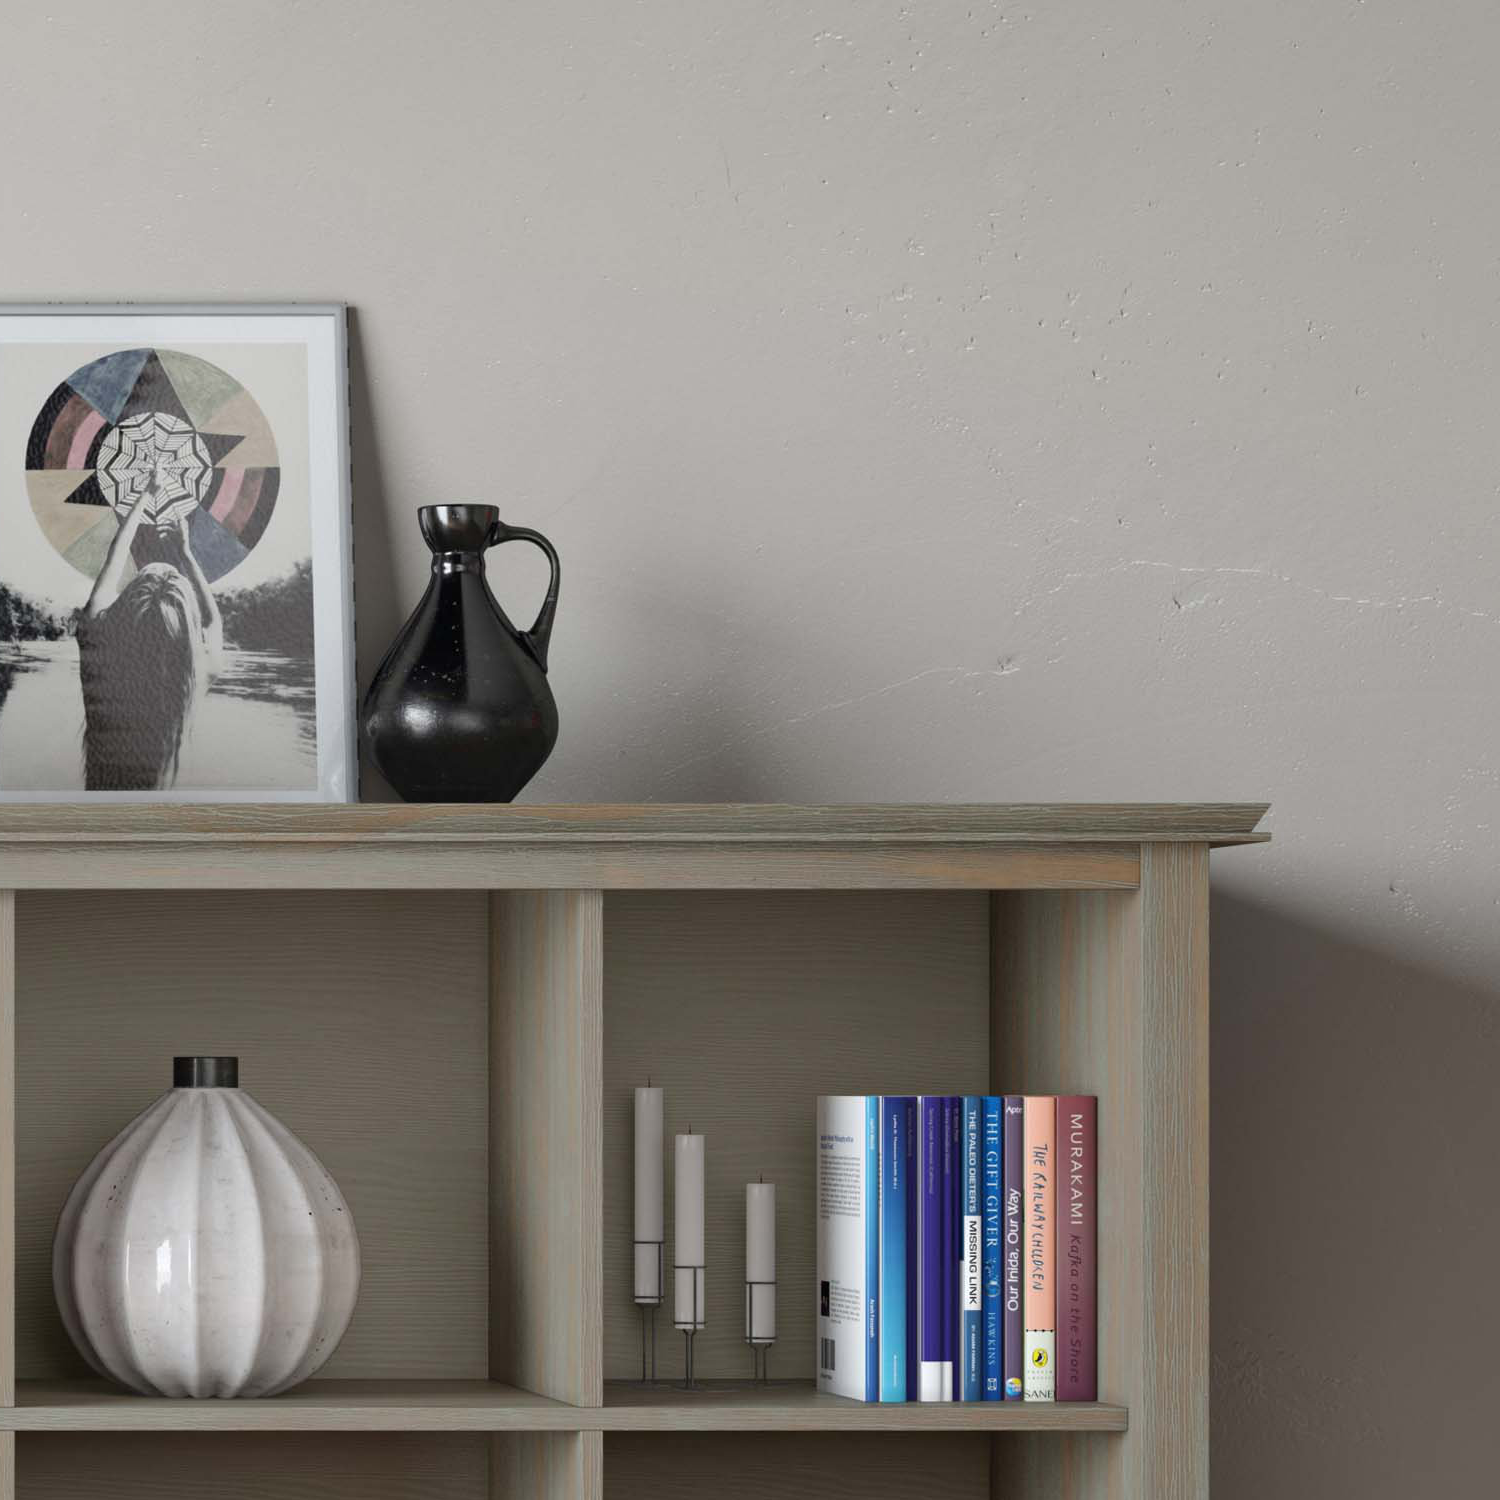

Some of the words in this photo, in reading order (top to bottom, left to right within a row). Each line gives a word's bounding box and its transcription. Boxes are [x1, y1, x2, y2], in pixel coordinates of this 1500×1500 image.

[968, 1110, 977, 1130] THE
[986, 1112, 998, 1144] THE
[968, 1132, 977, 1166] PALEO
[1033, 1144, 1048, 1168] THE
[986, 1150, 998, 1189] GIFT
[1070, 1113, 1083, 1225] MURAKAMI
[968, 1167, 977, 1213] DIETER'S
[1007, 1188, 1021, 1216] Way
[986, 1195, 998, 1247] GIVER
[1007, 1219, 1019, 1244] Our
[969, 1221, 978, 1273] MISSING
[1068, 1234, 1082, 1277] Kafka
[1007, 1248, 1020, 1282] Inida,
[969, 1276, 978, 1305] LINK
[1007, 1284, 1019, 1311] Our
[1070, 1283, 1079, 1299] on
[1070, 1308, 1082, 1333] the
[988, 1312, 997, 1366] HAWKINS
[1069, 1339, 1081, 1384] Shore
